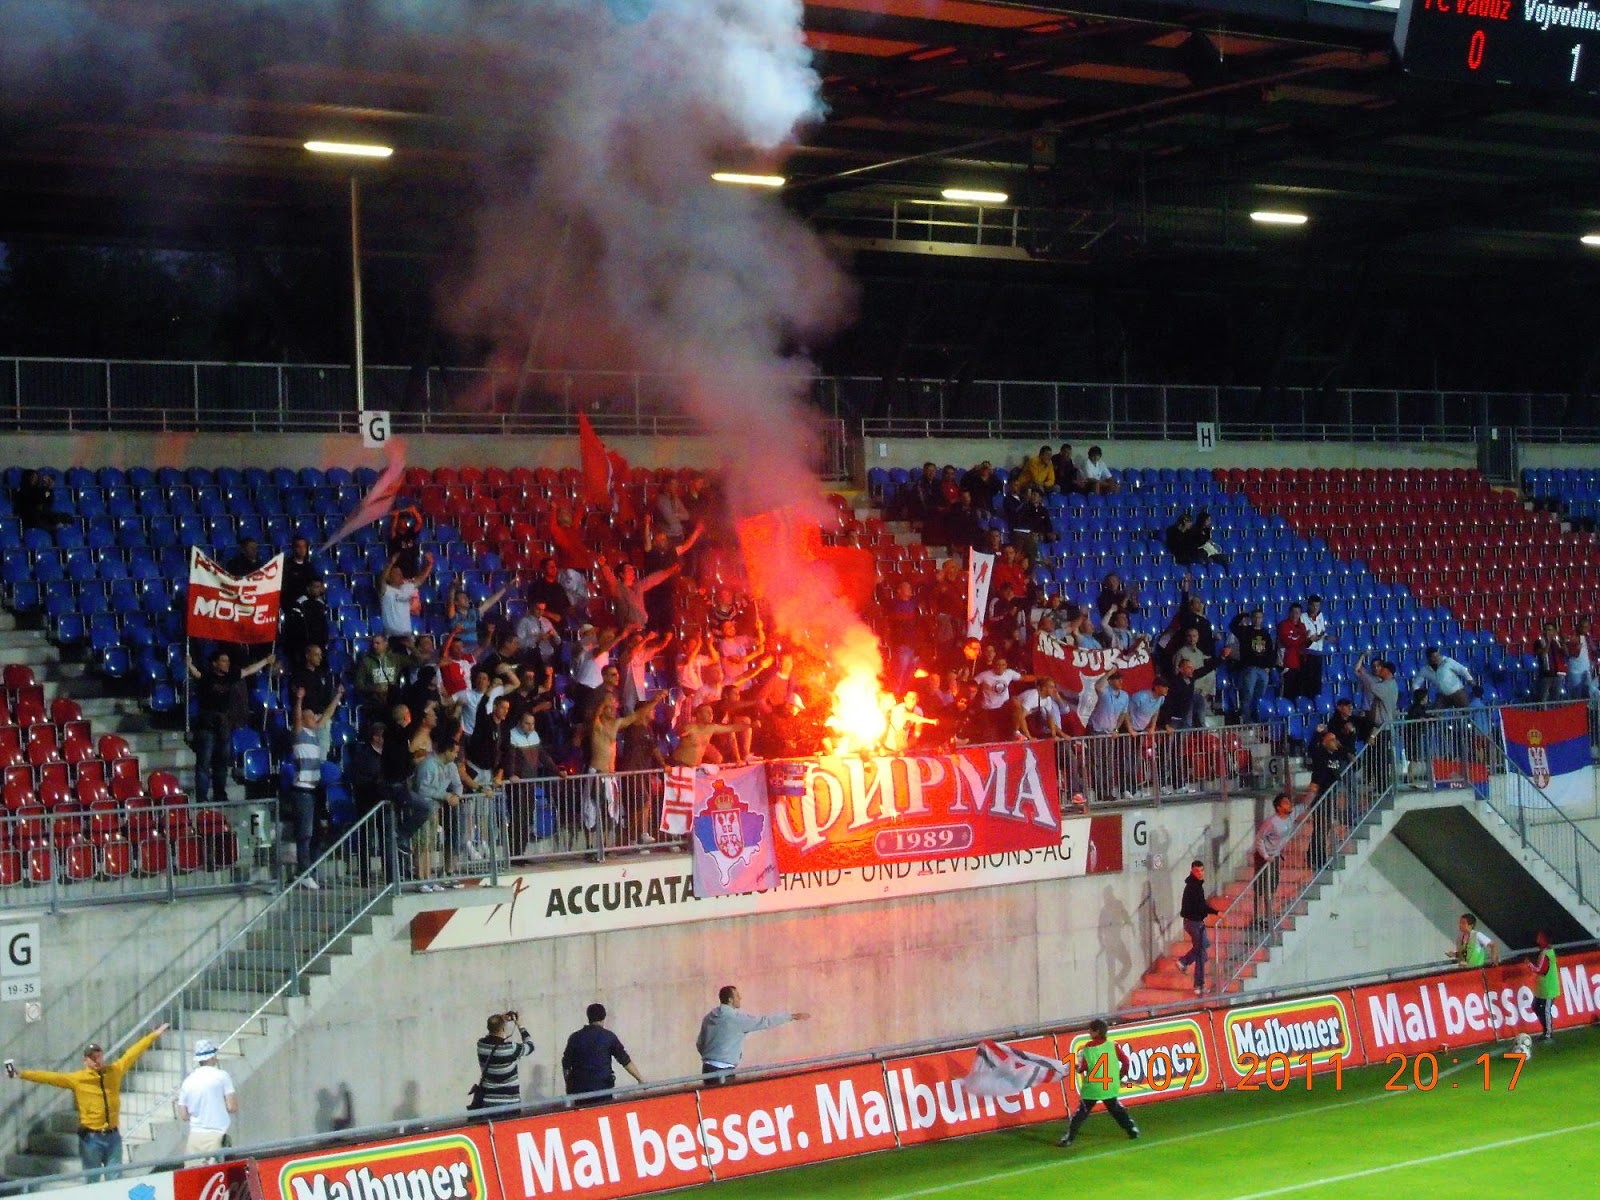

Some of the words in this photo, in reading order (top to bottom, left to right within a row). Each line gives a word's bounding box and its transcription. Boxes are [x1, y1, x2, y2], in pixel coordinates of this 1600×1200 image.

[1468, 30, 1485, 70] 0
[1571, 43, 1581, 82] 1
[369, 417, 385, 441] G
[1201, 428, 1211, 447] H
[775, 747, 1058, 852] ФИРМА
[896, 829, 954, 851] 1989
[1133, 820, 1147, 846] G
[545, 874, 702, 918] ACCURATA
[8, 932, 33, 967] G
[1368, 984, 1438, 1048] Mal
[1437, 982, 1559, 1036] besse.
[1231, 1016, 1340, 1058] Malbuner
[517, 1116, 621, 1198] Mal
[626, 1111, 809, 1178] besser.
